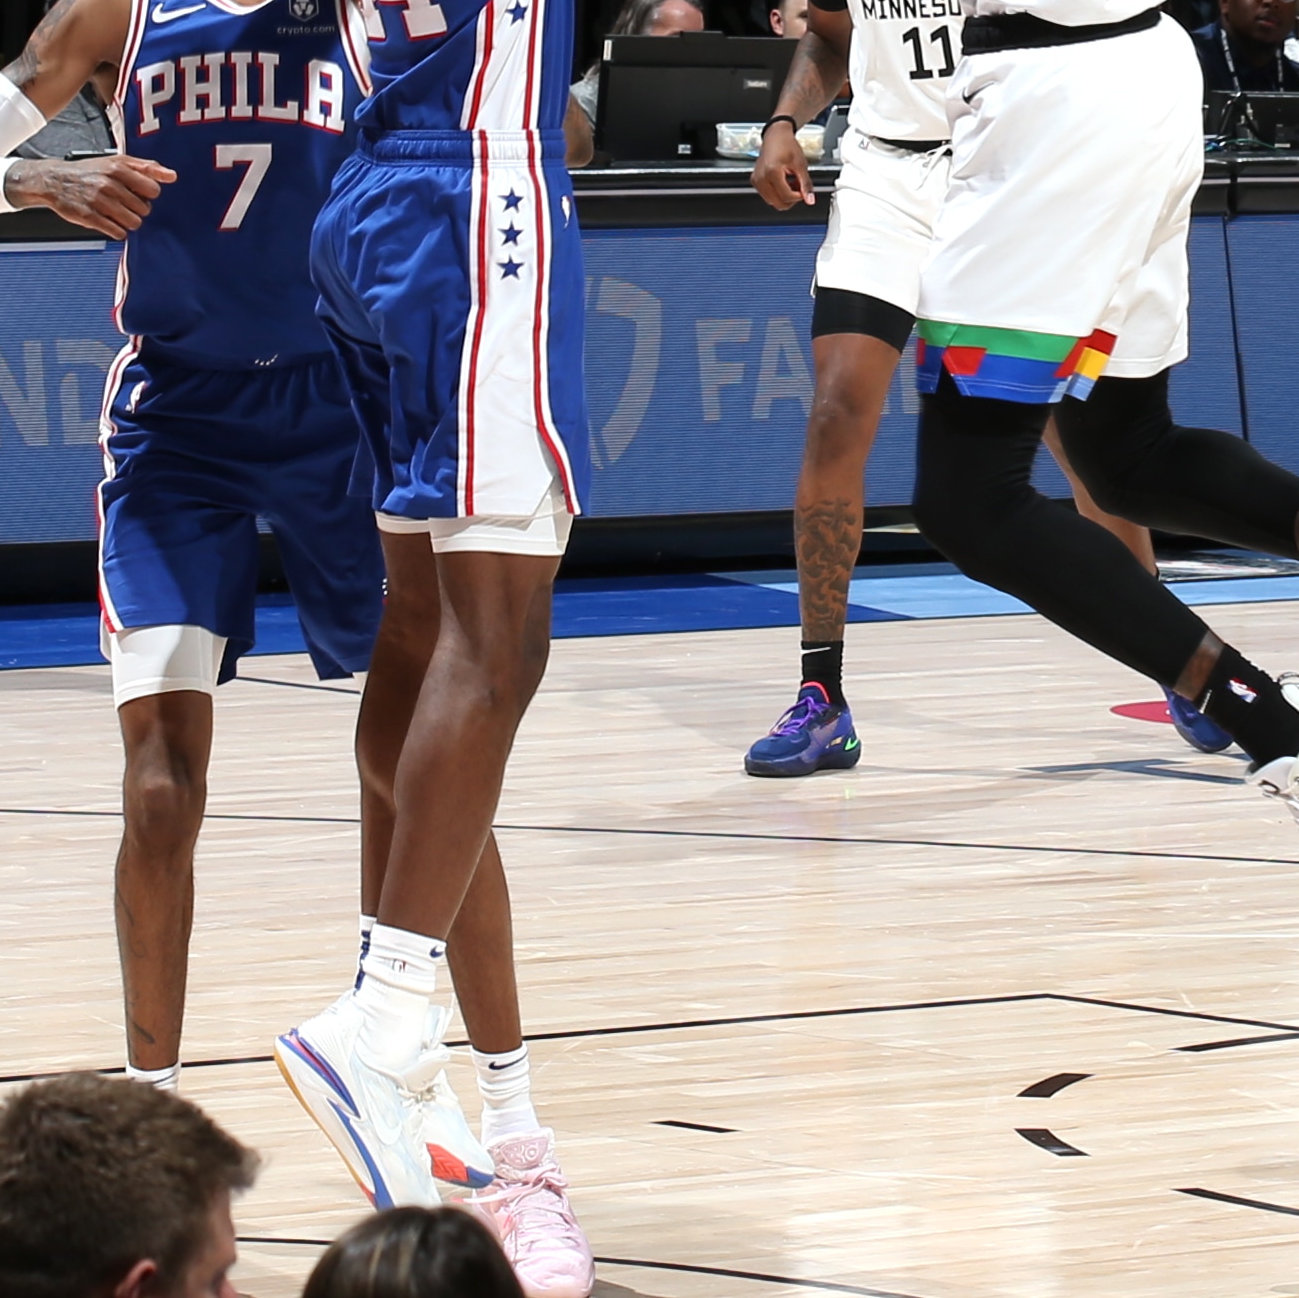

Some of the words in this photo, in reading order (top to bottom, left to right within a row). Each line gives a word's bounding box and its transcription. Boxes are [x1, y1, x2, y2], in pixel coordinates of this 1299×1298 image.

[277, 25, 336, 35] crypto.com
[902, 24, 957, 80] 11
[135, 51, 346, 137] PHILA
[213, 142, 273, 232] 7
